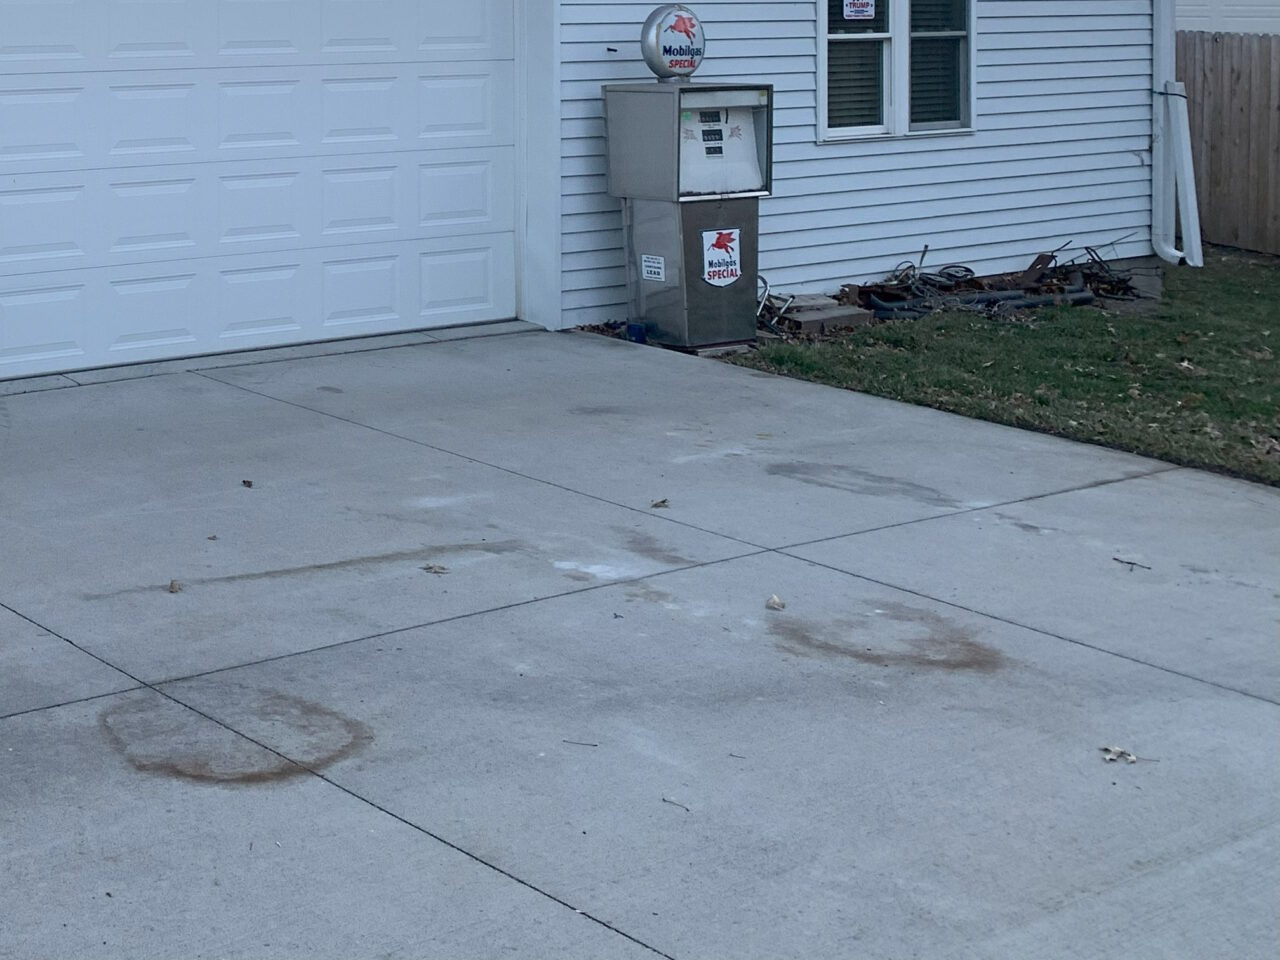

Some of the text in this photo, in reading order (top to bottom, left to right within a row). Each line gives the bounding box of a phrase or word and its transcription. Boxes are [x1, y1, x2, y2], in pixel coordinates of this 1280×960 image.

[849, 1, 870, 9] TRUMP
[662, 45, 702, 59] Mobilgas
[668, 59, 696, 69] SPECIAL
[708, 259, 737, 269] Mobilgas
[707, 268, 738, 280] SPECIAL
